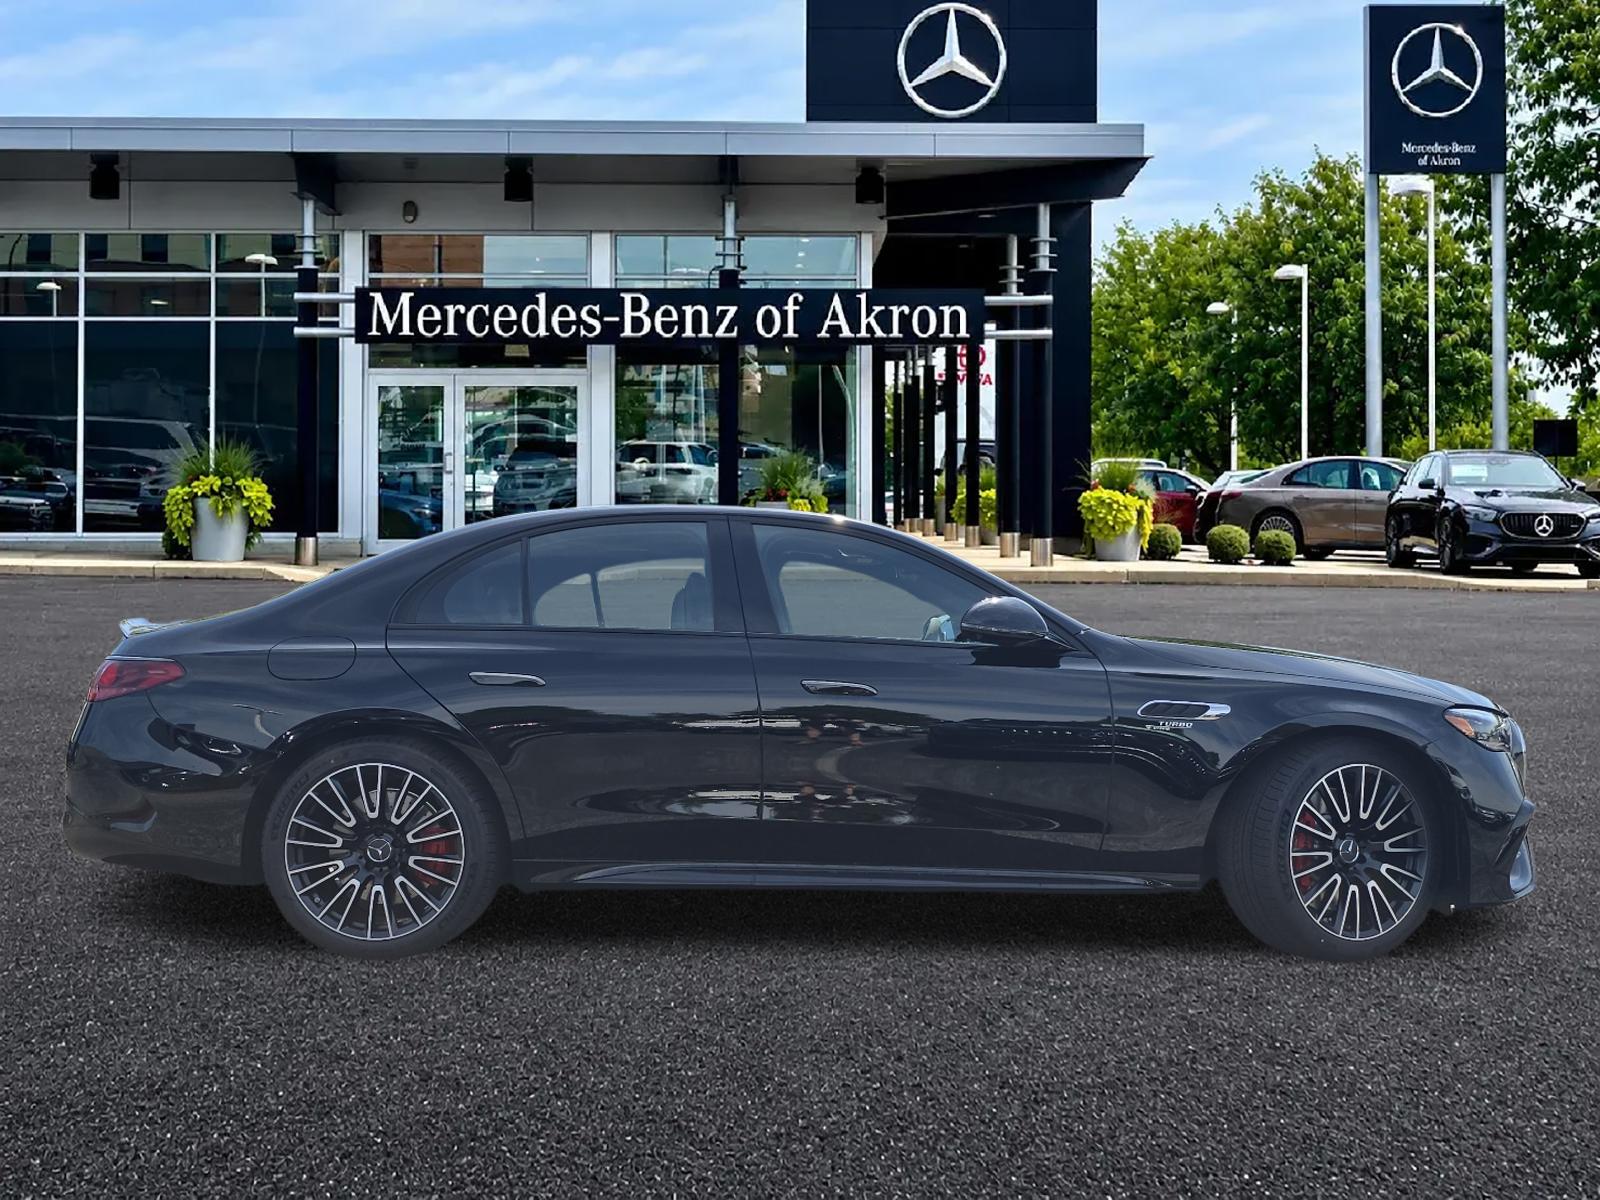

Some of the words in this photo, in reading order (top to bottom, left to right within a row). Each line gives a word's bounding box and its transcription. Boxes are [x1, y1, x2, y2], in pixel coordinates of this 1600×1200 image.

[1401, 142, 1476, 153] Mercedes-Benz
[1417, 154, 1429, 166] of
[1430, 154, 1461, 166] Akron
[368, 291, 738, 338] Mercedes-Benz
[755, 291, 805, 338] of
[816, 291, 971, 338] Akron
[1159, 720, 1194, 729] TURBO
